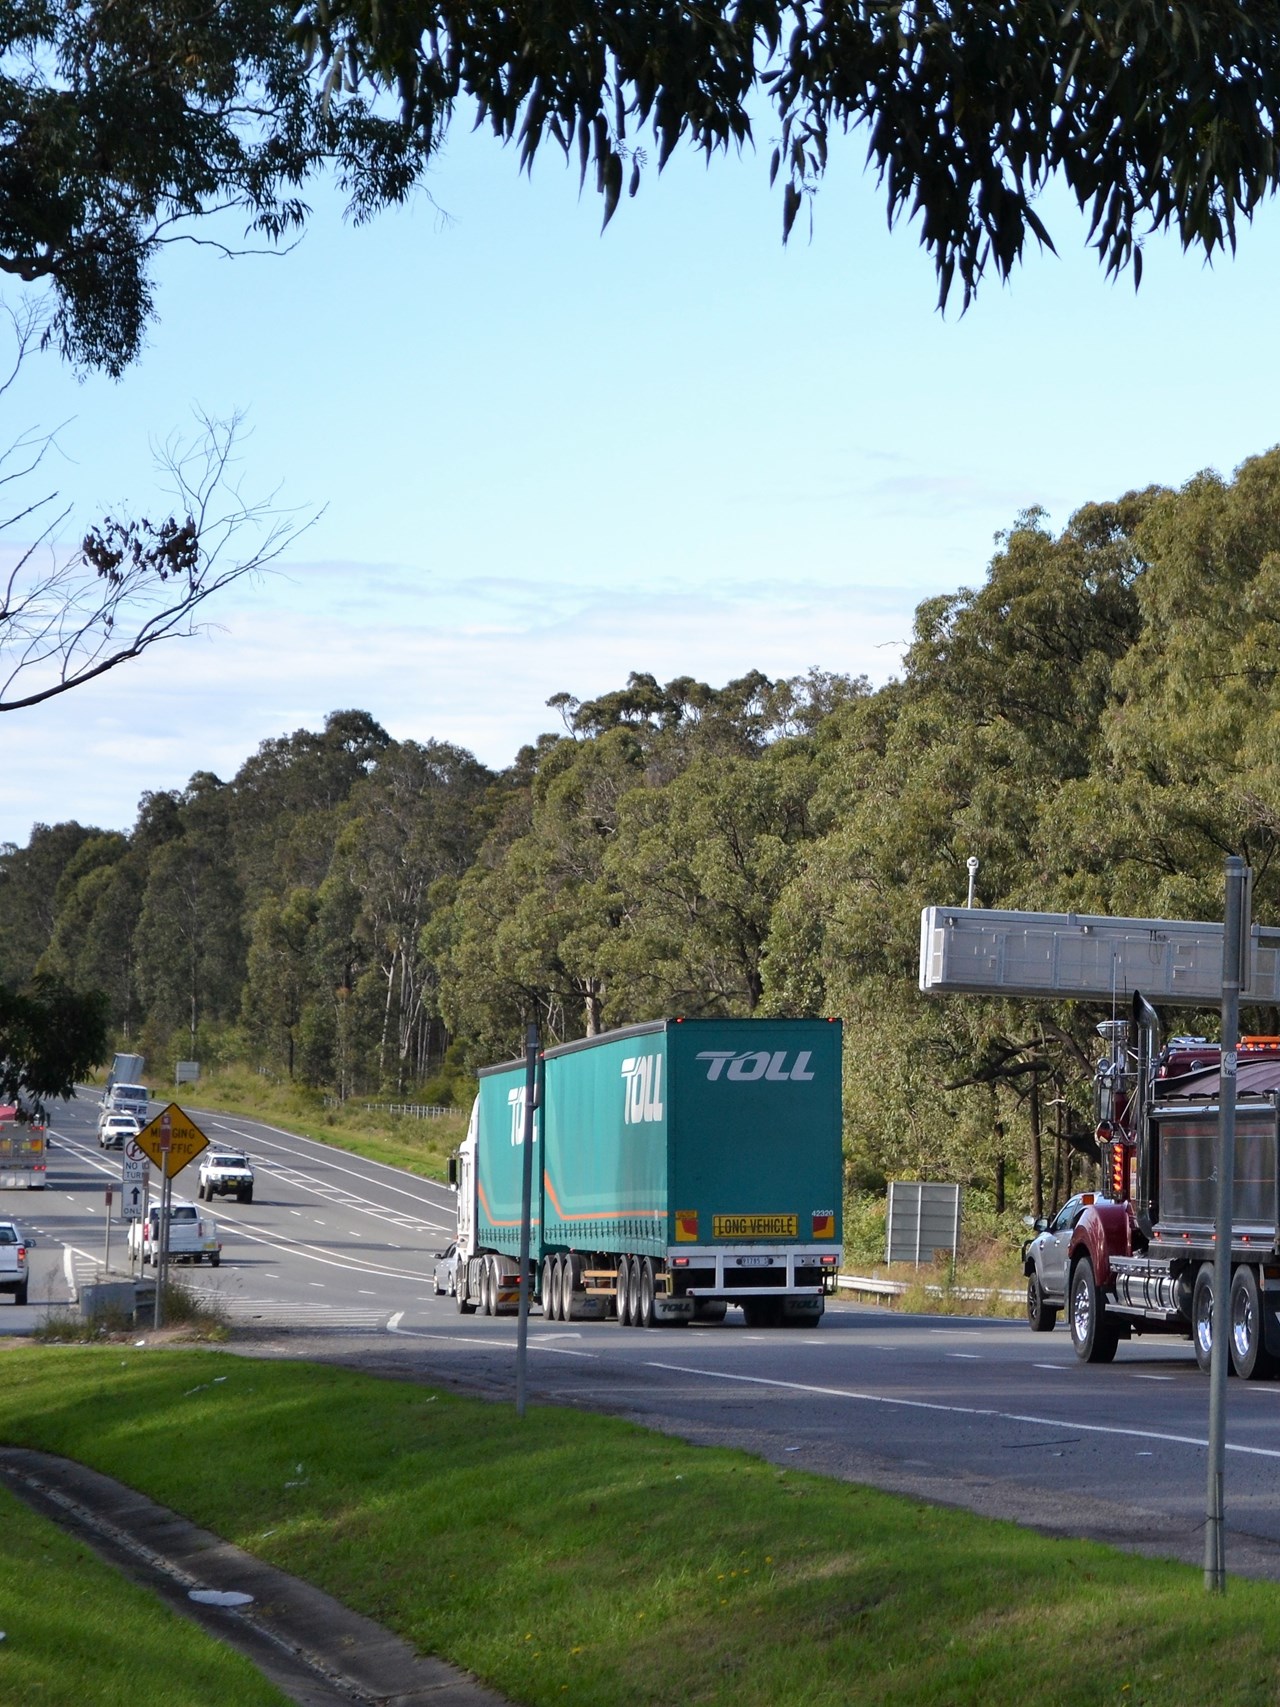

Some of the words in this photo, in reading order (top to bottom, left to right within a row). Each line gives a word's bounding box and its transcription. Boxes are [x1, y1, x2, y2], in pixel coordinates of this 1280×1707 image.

[695, 1051, 815, 1081] TOLL
[621, 1054, 663, 1125] TOLL
[150, 1128, 195, 1139] MGING
[152, 1143, 193, 1155] TFFIC
[125, 1162, 138, 1170] NO
[718, 1217, 747, 1235] LONG
[750, 1216, 793, 1234] VEHICLE
[658, 1303, 692, 1313] TOLL
[788, 1300, 819, 1309] TOLL
